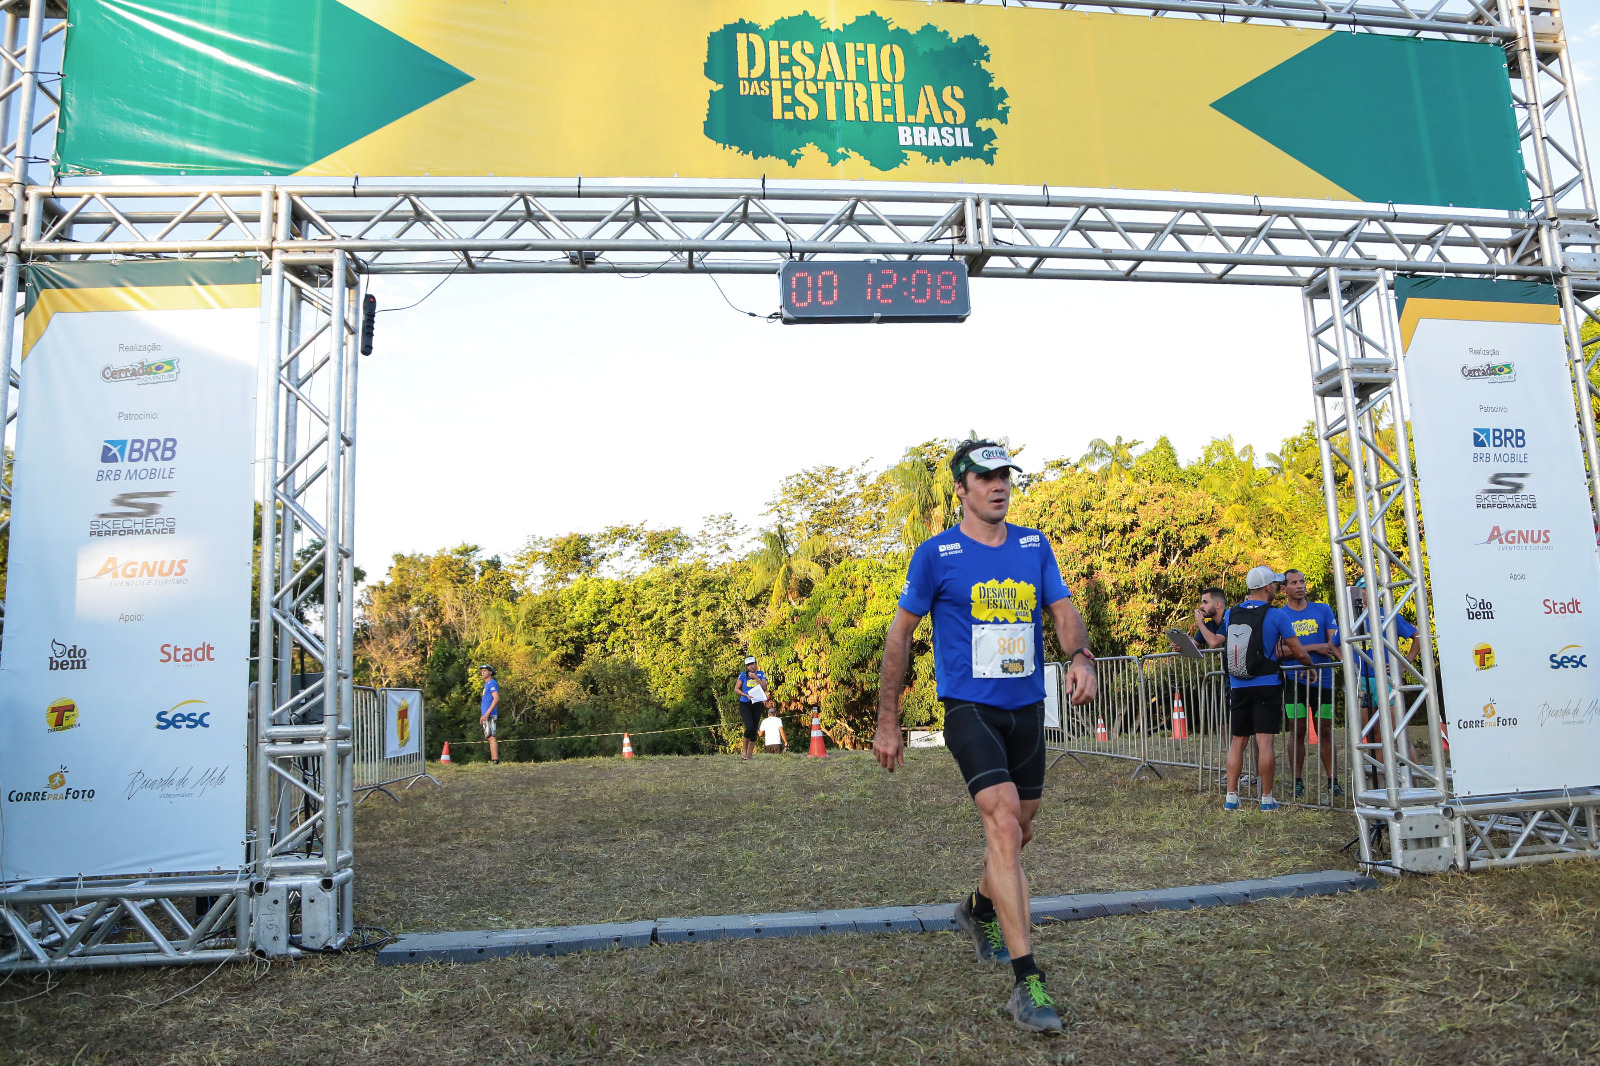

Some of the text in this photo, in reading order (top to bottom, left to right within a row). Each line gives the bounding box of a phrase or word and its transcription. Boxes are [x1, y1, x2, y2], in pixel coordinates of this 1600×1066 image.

[736, 32, 905, 83] DESAFIO
[739, 80, 967, 125] DAS ESTRELAS
[898, 126, 974, 147] BRASIL
[791, 269, 957, 307] 00 12:08
[118, 343, 164, 353] Realização:
[101, 361, 152, 380] Cerrado
[1461, 363, 1497, 377] Cerrado
[118, 411, 159, 421] Patrocínio:
[1493, 429, 1526, 448] BRB
[128, 438, 177, 462] BRB
[1473, 453, 1528, 463] BRB MOBILE
[96, 468, 176, 482] BRB MOBILE
[1475, 494, 1537, 503] SKECHERS
[90, 518, 176, 530] SKECHERS
[89, 528, 176, 538] PERFORMANCE
[1026, 535, 1040, 543] BRB
[1487, 526, 1550, 545] AGNUS
[946, 542, 961, 551] BRB
[95, 556, 188, 579] AGNUS
[979, 586, 1017, 599] DESAFIO
[1479, 599, 1492, 610] do
[1543, 597, 1582, 615] Stadt
[119, 612, 144, 623] Apoio:
[1466, 608, 1494, 620] bem
[67, 645, 87, 659] do
[159, 641, 215, 663] Stadt
[998, 637, 1026, 655] 800
[49, 657, 87, 671] bem
[50, 703, 75, 727] T
